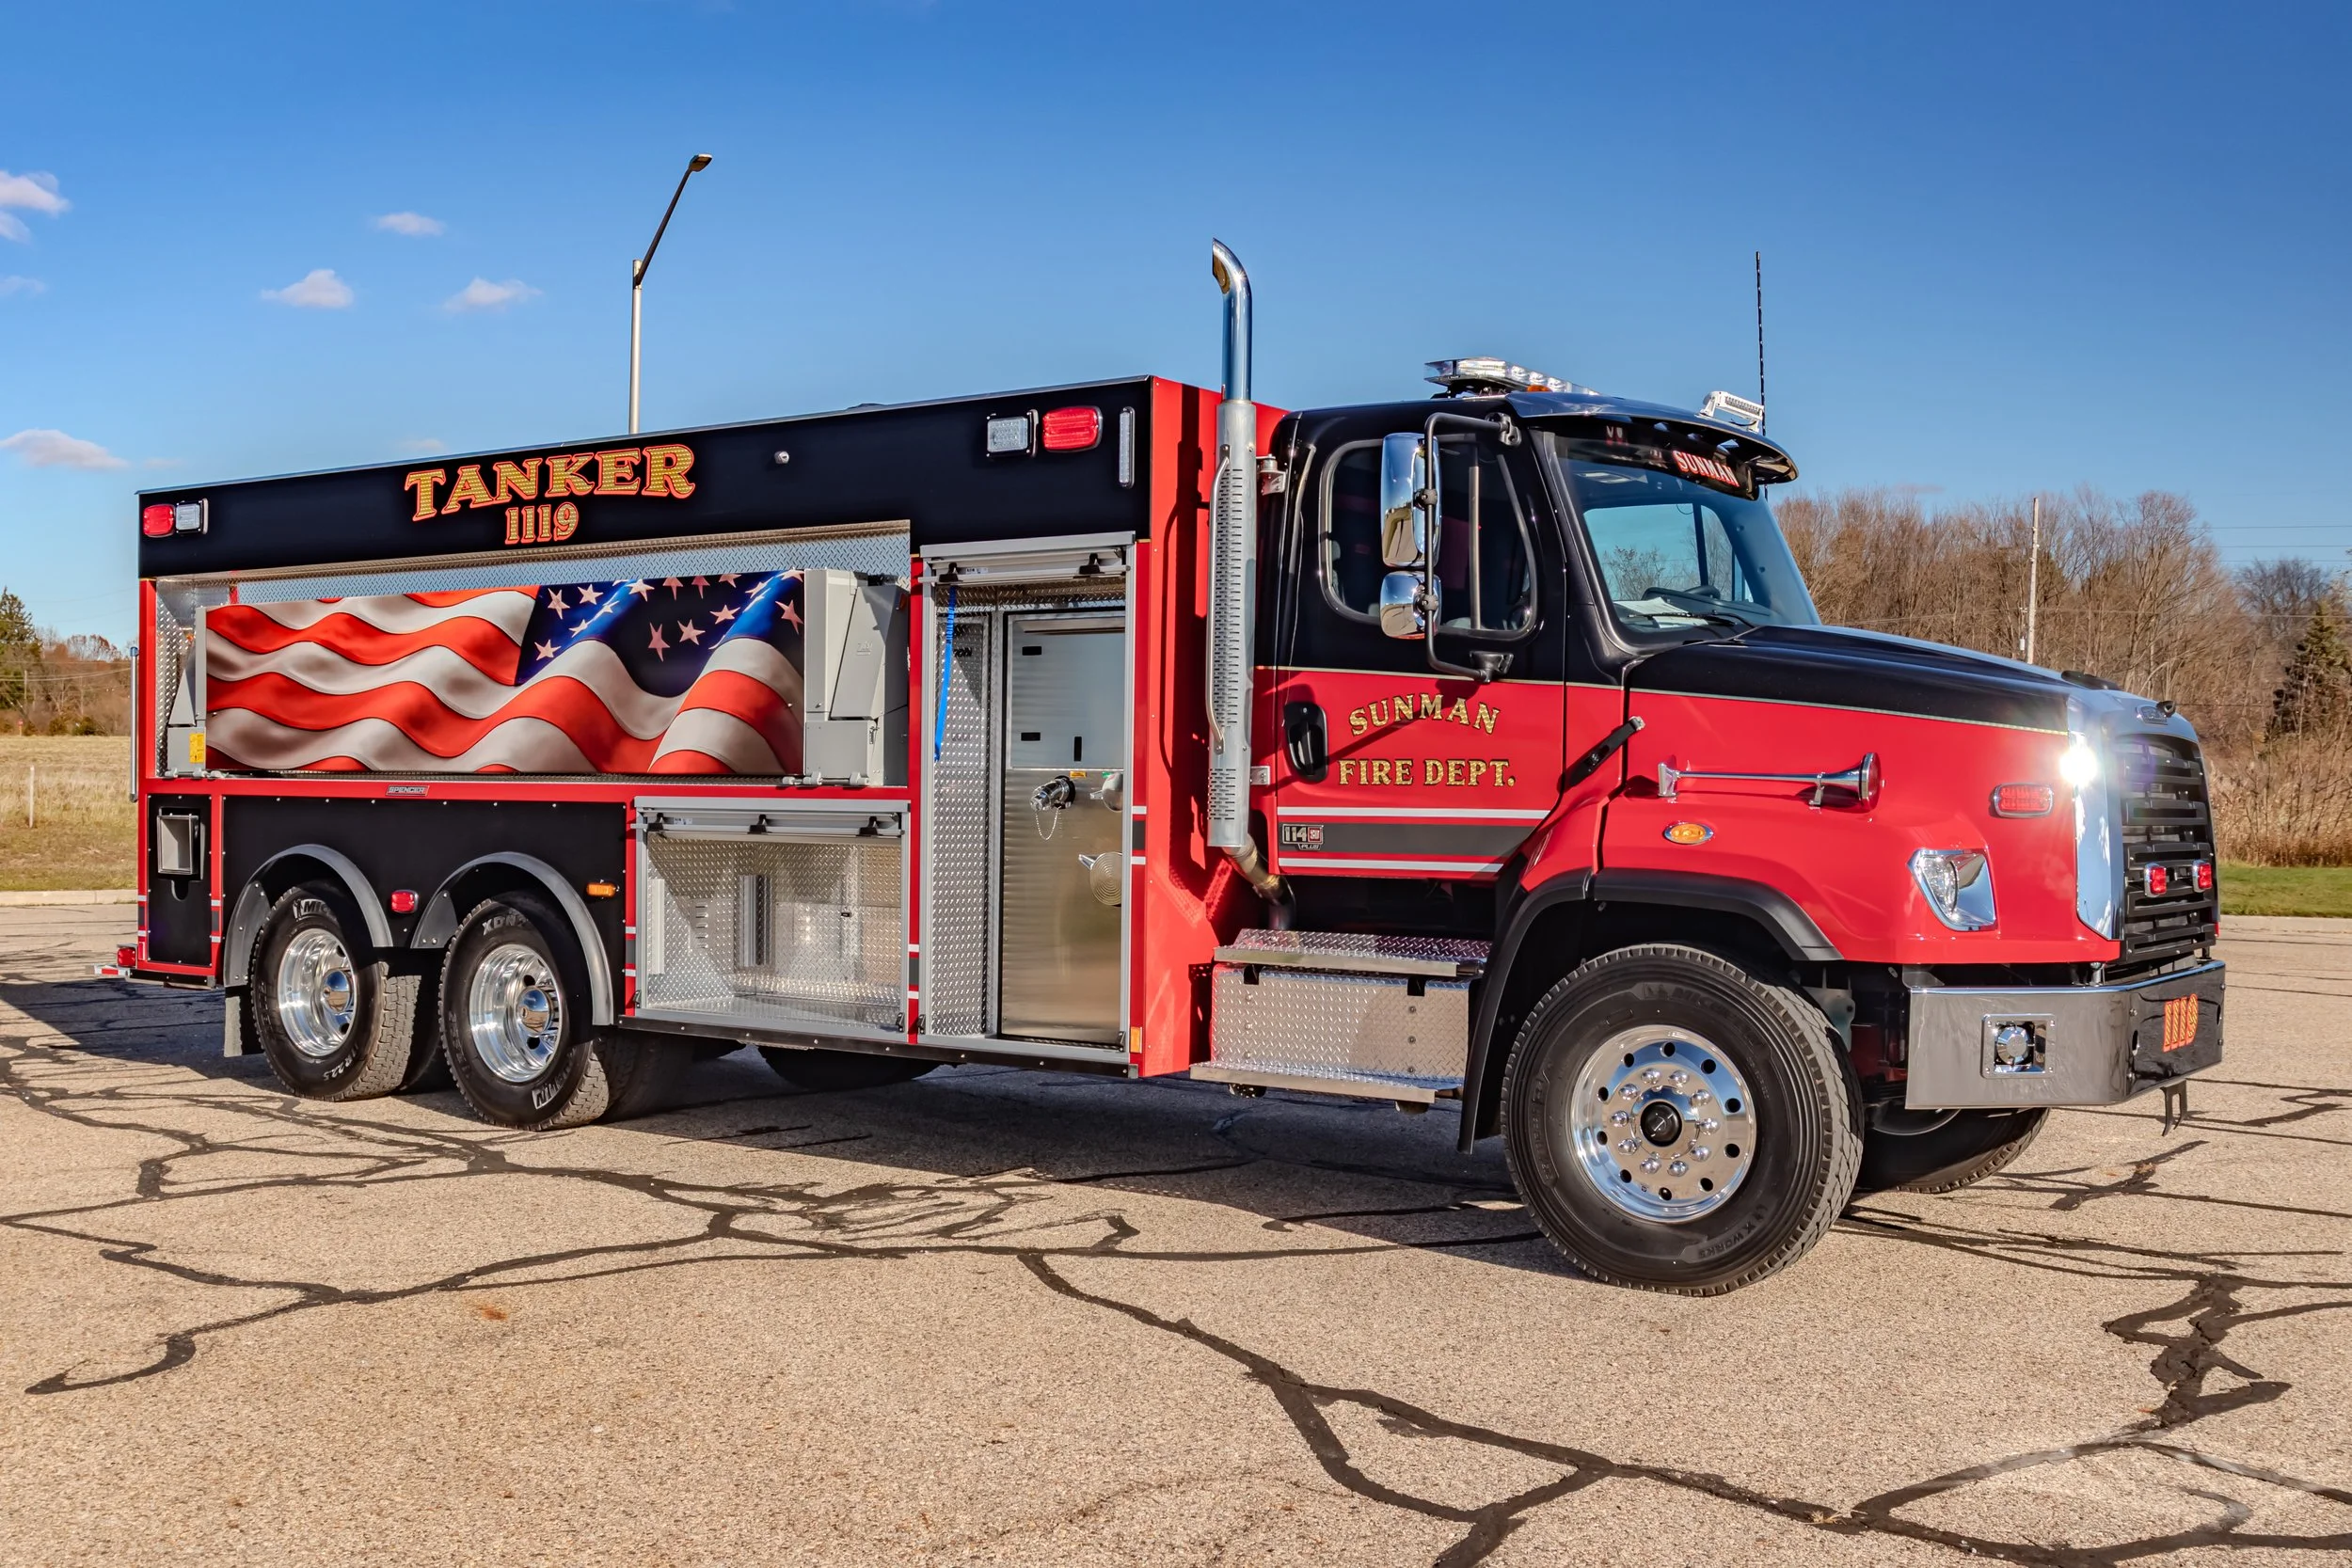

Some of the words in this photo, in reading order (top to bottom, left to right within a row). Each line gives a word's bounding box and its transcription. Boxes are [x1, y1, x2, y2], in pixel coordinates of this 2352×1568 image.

[405, 444, 695, 521] TANKER
[1673, 451, 1740, 487] SUNMAN
[505, 501, 579, 545] 1119
[1347, 692, 1501, 736] SUNMAN
[1338, 758, 1414, 786] FIRE
[1422, 758, 1517, 787] DEPT.
[2163, 993, 2199, 1053] 1119
